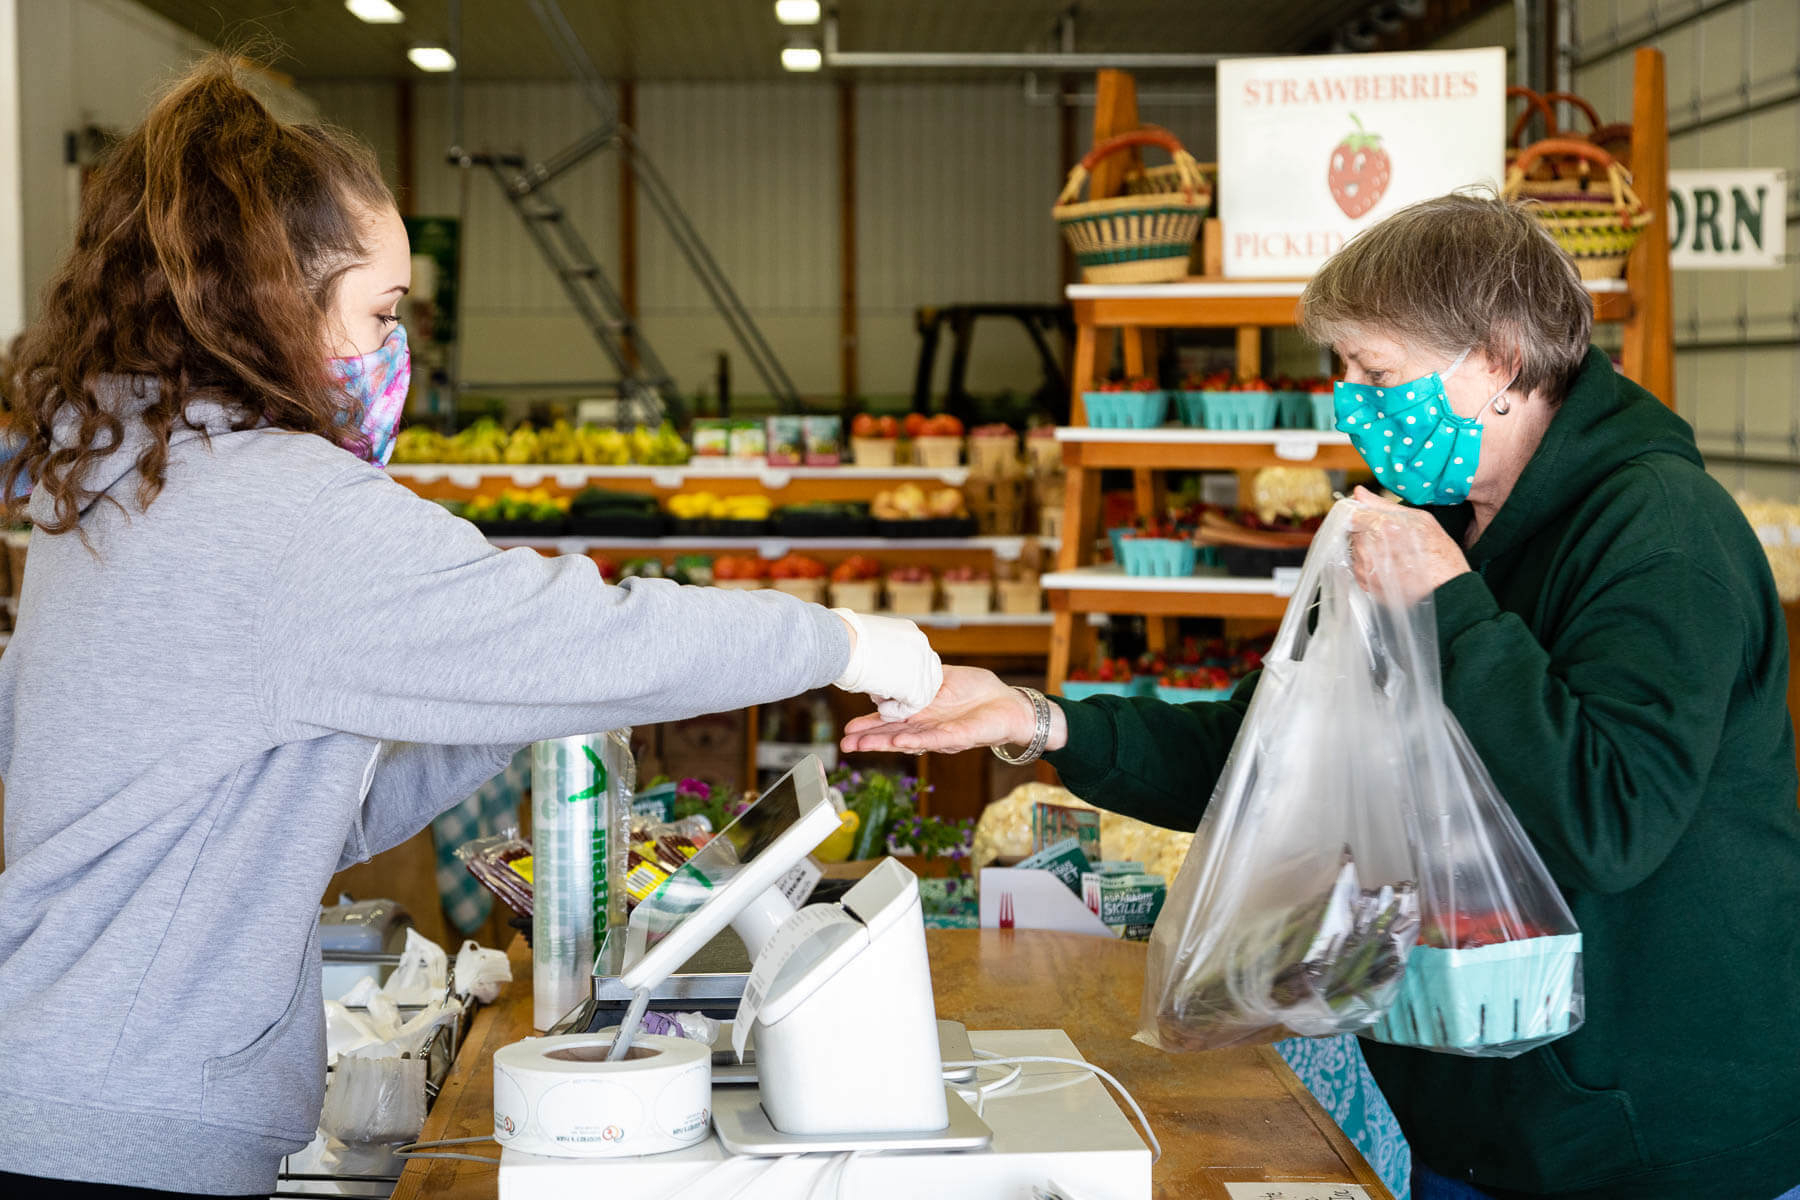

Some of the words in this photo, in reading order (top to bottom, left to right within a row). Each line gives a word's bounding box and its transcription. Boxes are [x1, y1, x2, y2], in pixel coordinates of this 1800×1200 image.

[1243, 71, 1479, 106] STRAWBERRIES
[1233, 231, 1347, 259] PICKED
[1103, 901, 1155, 916] SKILLET
